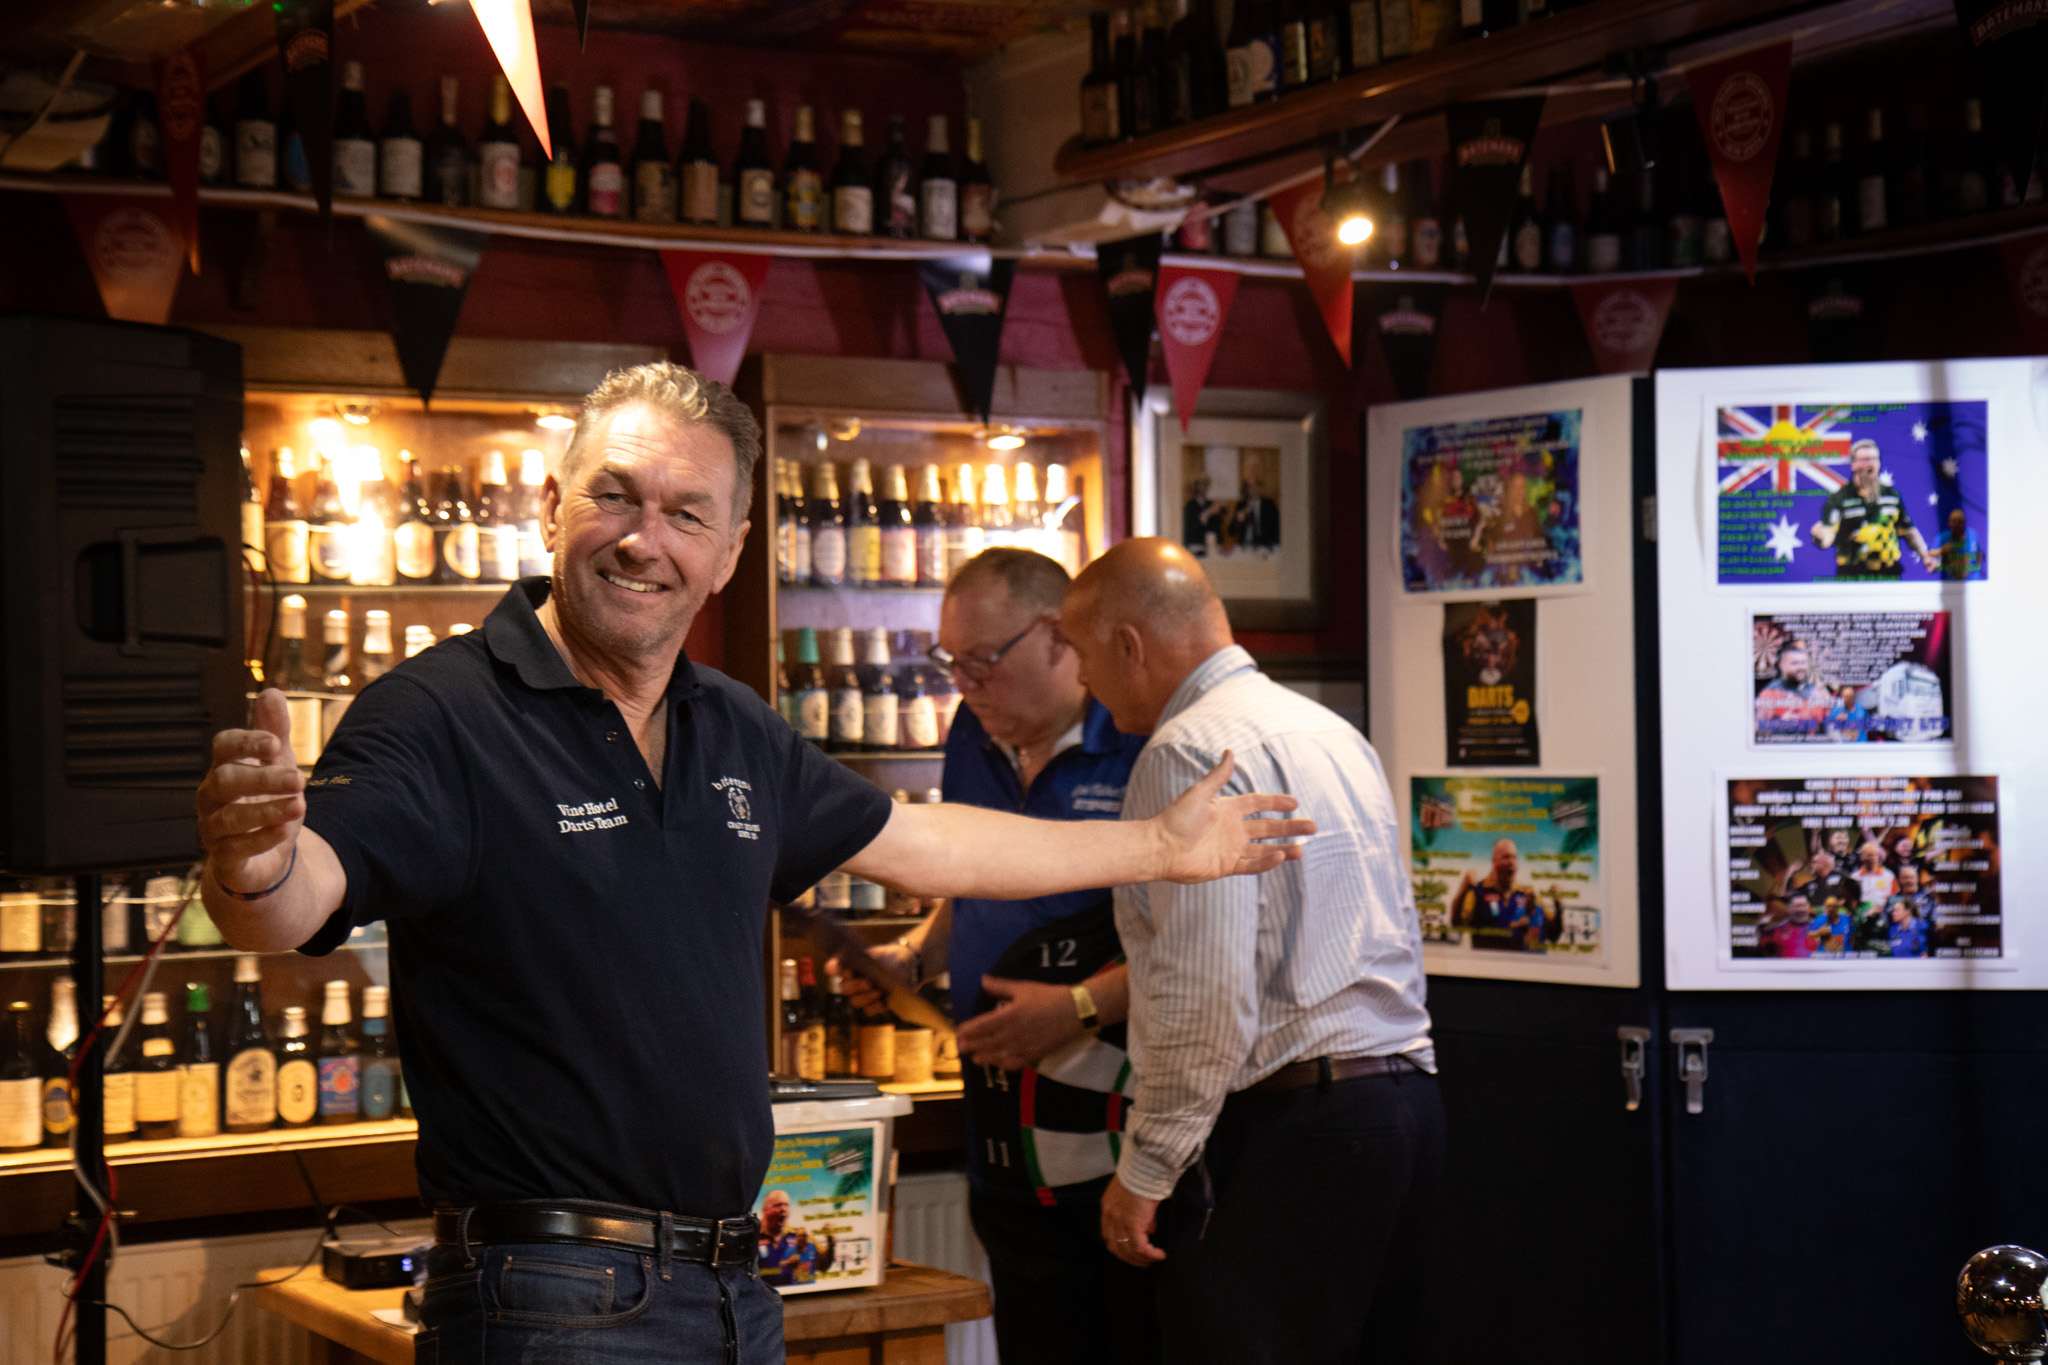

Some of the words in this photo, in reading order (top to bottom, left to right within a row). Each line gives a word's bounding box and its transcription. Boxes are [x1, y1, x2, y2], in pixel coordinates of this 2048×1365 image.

[556, 803, 585, 817] Vine
[583, 797, 620, 815] Hotel
[557, 819, 596, 834] Darts
[593, 815, 629, 830] Team
[1040, 938, 1079, 968] 12
[985, 1138, 1012, 1168] 11
